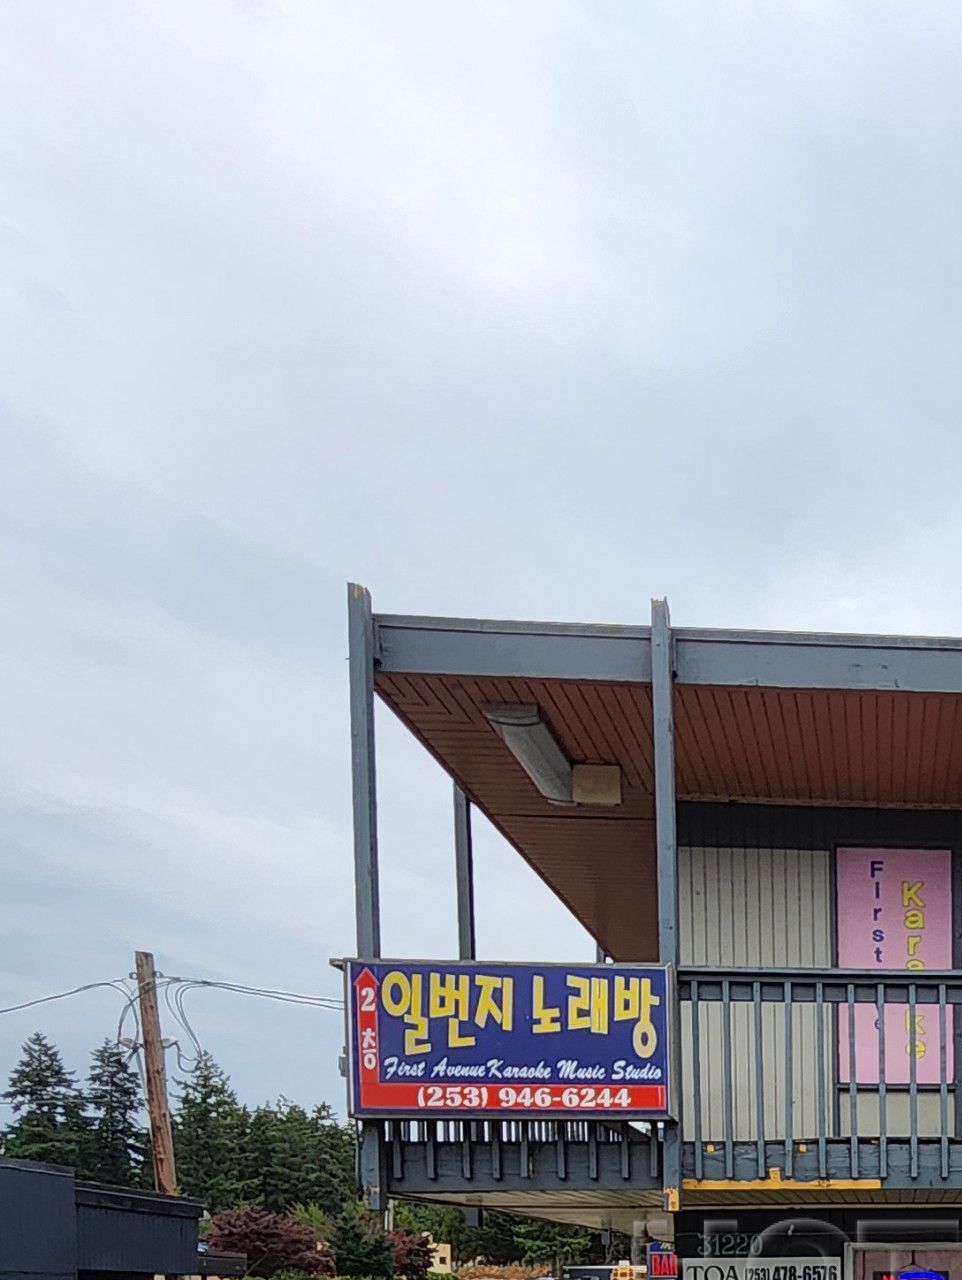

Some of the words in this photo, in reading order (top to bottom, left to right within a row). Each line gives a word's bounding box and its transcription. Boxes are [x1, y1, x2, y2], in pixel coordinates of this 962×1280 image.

[901, 880, 926, 1060] Karke
[381, 970, 514, 1056] 일번지
[532, 973, 660, 1059] 노래방
[383, 1056, 425, 1080] First
[432, 1057, 486, 1078] Avenue
[486, 1057, 551, 1079] Karaoke
[556, 1059, 605, 1080] Music
[611, 1060, 662, 1081] Studio
[417, 1087, 488, 1108] (253)
[498, 1087, 632, 1109] 946-6244
[697, 1232, 763, 1256] 31220
